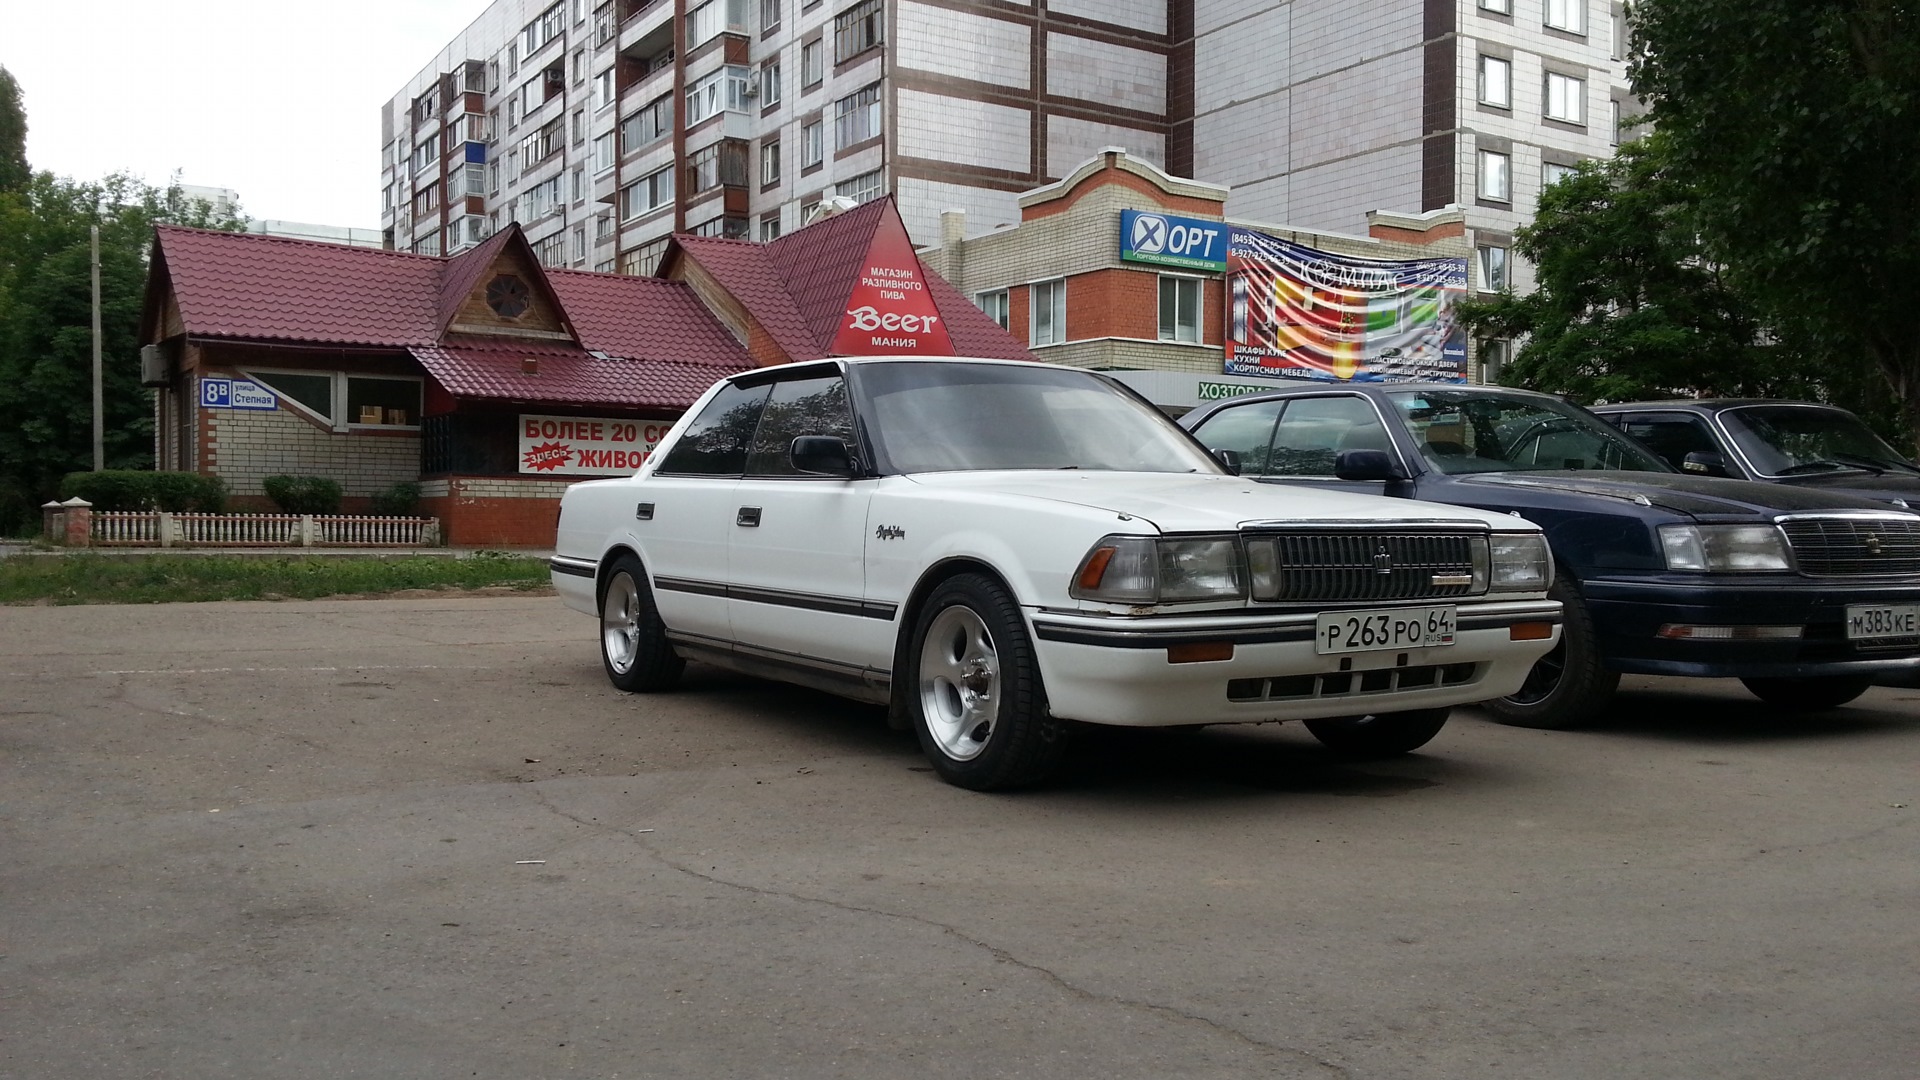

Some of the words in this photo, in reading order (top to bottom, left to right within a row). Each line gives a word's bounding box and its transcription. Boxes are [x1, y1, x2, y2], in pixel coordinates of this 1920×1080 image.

[871, 267, 913, 279] МАГАЗИН
[862, 278, 922, 290] РАЗЛИВНОГО
[880, 290, 906, 300] ПИВА
[847, 305, 938, 334] Beer
[871, 336, 917, 348] МАНИЯ
[1233, 345, 1266, 355] ШКАФЫ
[1233, 354, 1260, 364] КУХНИ
[1438, 360, 1458, 368] ДВЕРИ
[1233, 364, 1280, 375] КОРПУСНАЯ
[1281, 367, 1311, 378] МЕБЕЛЬ
[1416, 369, 1459, 379] КОНСТРУКЦИИ
[234, 393, 272, 404] Степная
[525, 419, 603, 441] БОЛЕЕ
[611, 424, 636, 443] 20
[530, 448, 567, 464] ЗДЕСЬ
[1427, 610, 1449, 633] 64
[1426, 633, 1441, 643] RUS
